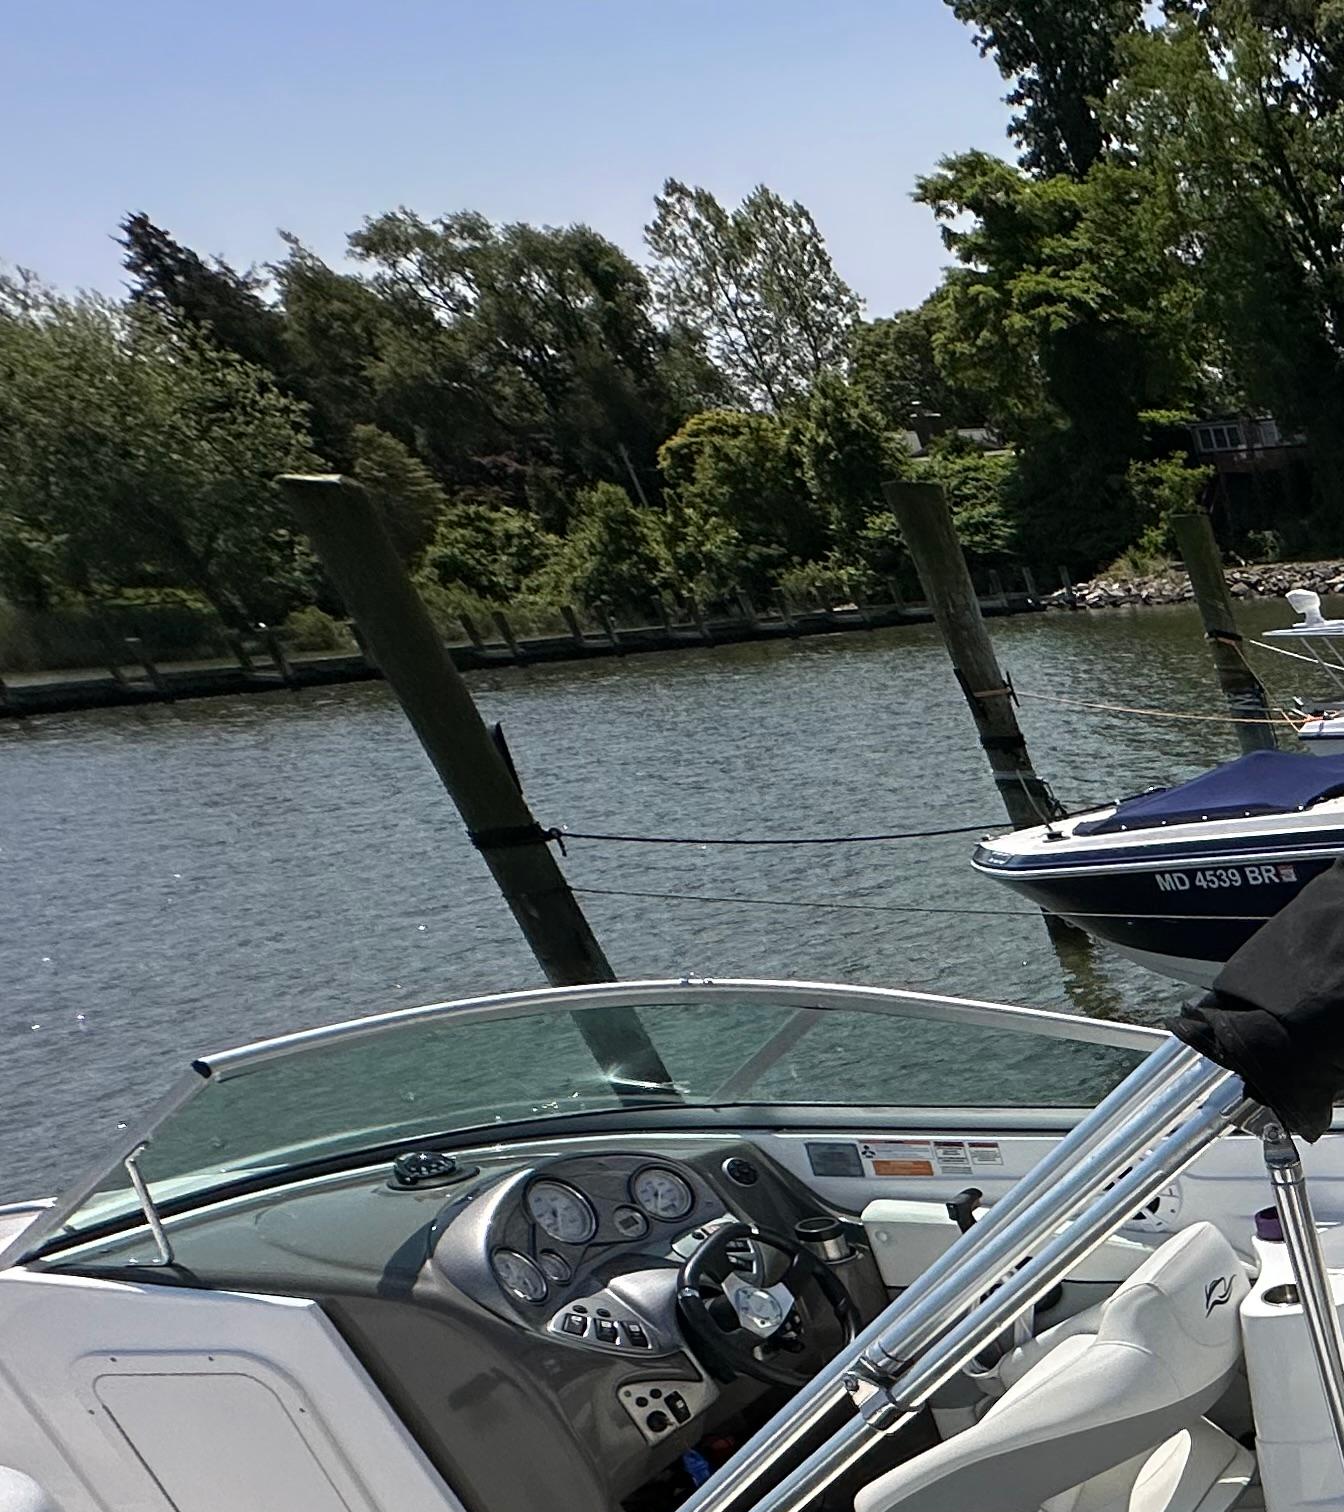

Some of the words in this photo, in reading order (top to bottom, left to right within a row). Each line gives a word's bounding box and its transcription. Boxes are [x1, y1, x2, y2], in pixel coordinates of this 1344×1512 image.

[1154, 872, 1190, 892] MD
[1194, 868, 1242, 889] 4539
[1244, 865, 1280, 885] BR
